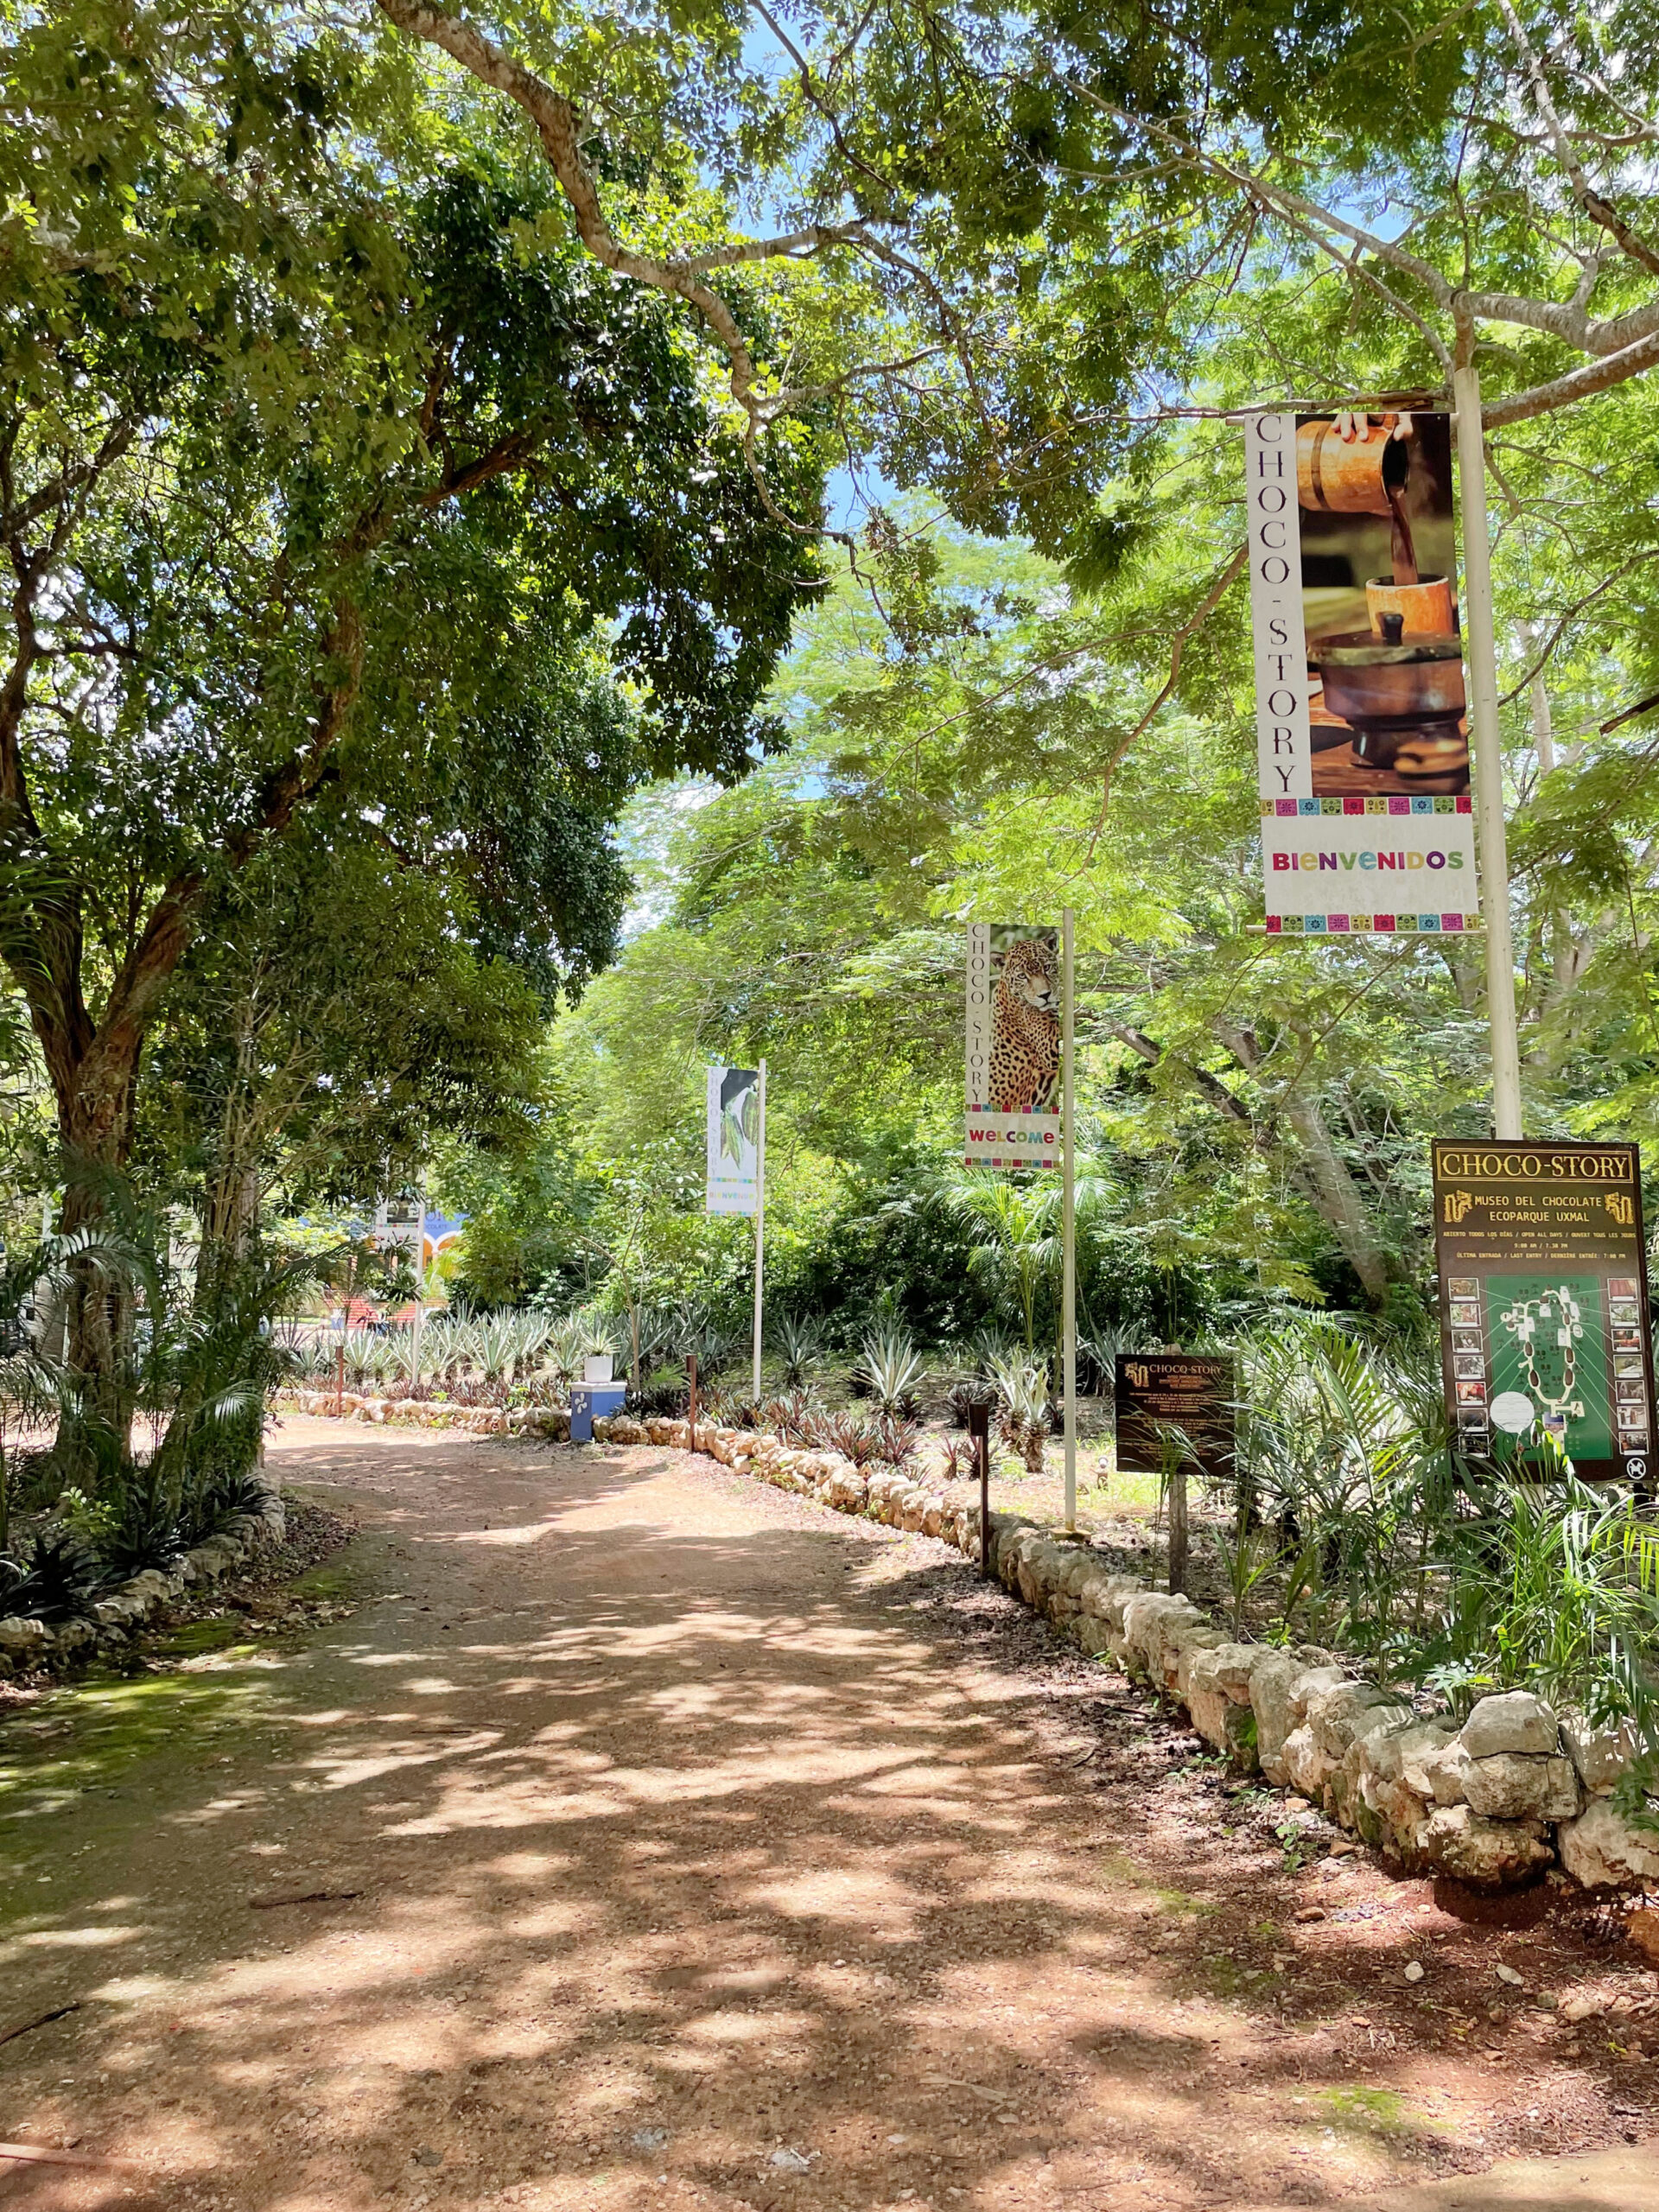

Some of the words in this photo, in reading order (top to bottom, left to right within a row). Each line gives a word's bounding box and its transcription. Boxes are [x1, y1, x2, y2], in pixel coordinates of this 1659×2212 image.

[1255, 415, 1299, 794] CHOCO-STORY
[969, 925, 986, 1103] CHOCO-STORY
[709, 1068, 719, 1176] CHOCOSTORY
[1441, 1154, 1628, 1178] CHOCO-STORY
[1474, 1195, 1510, 1206] MUSEO
[1515, 1196, 1535, 1206] DEL
[1541, 1197, 1602, 1207] CHOCOLATE
[1489, 1211, 1549, 1224] ECOPARQUE
[1556, 1211, 1590, 1222] UXMAL
